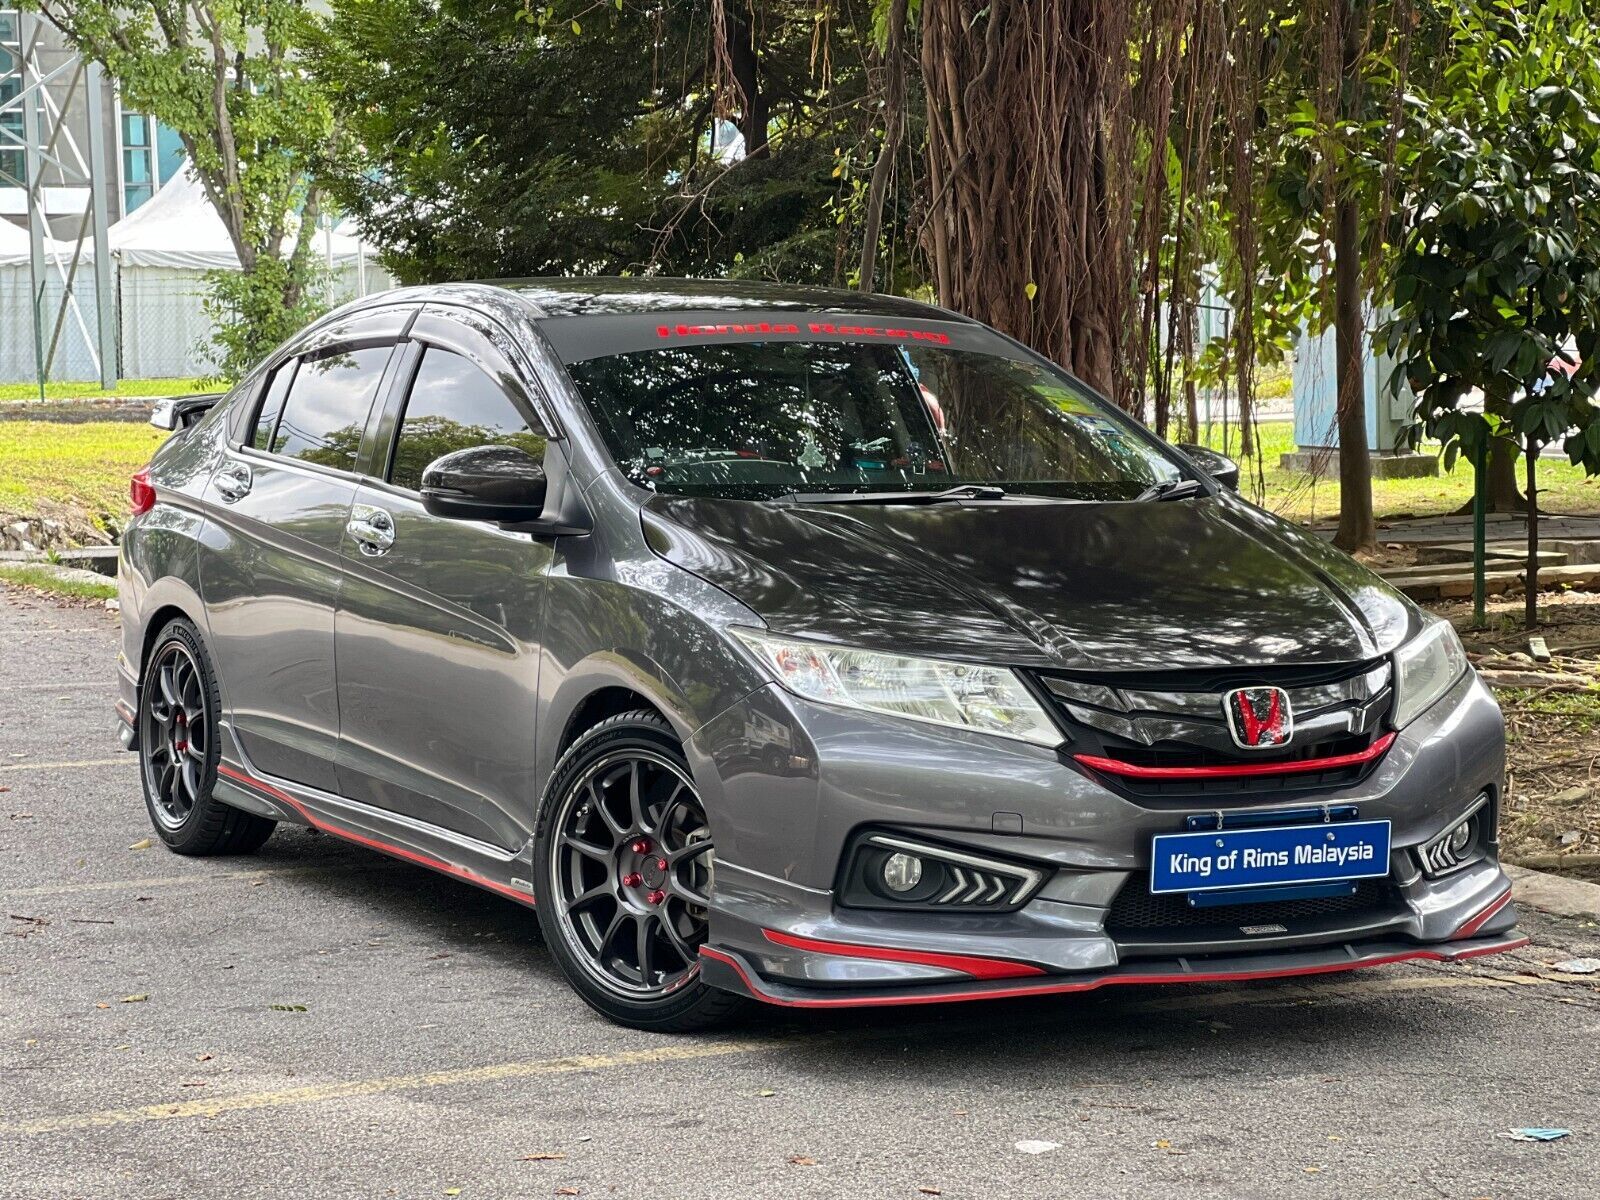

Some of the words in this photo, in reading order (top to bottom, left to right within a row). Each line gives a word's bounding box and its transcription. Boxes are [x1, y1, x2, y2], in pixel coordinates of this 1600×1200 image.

[657, 323, 799, 338] Honda
[807, 323, 950, 344] Racing
[1170, 853, 1212, 876] King
[1217, 850, 1238, 870] of
[1243, 848, 1288, 868] Rims
[1294, 841, 1374, 866] Malaysia
